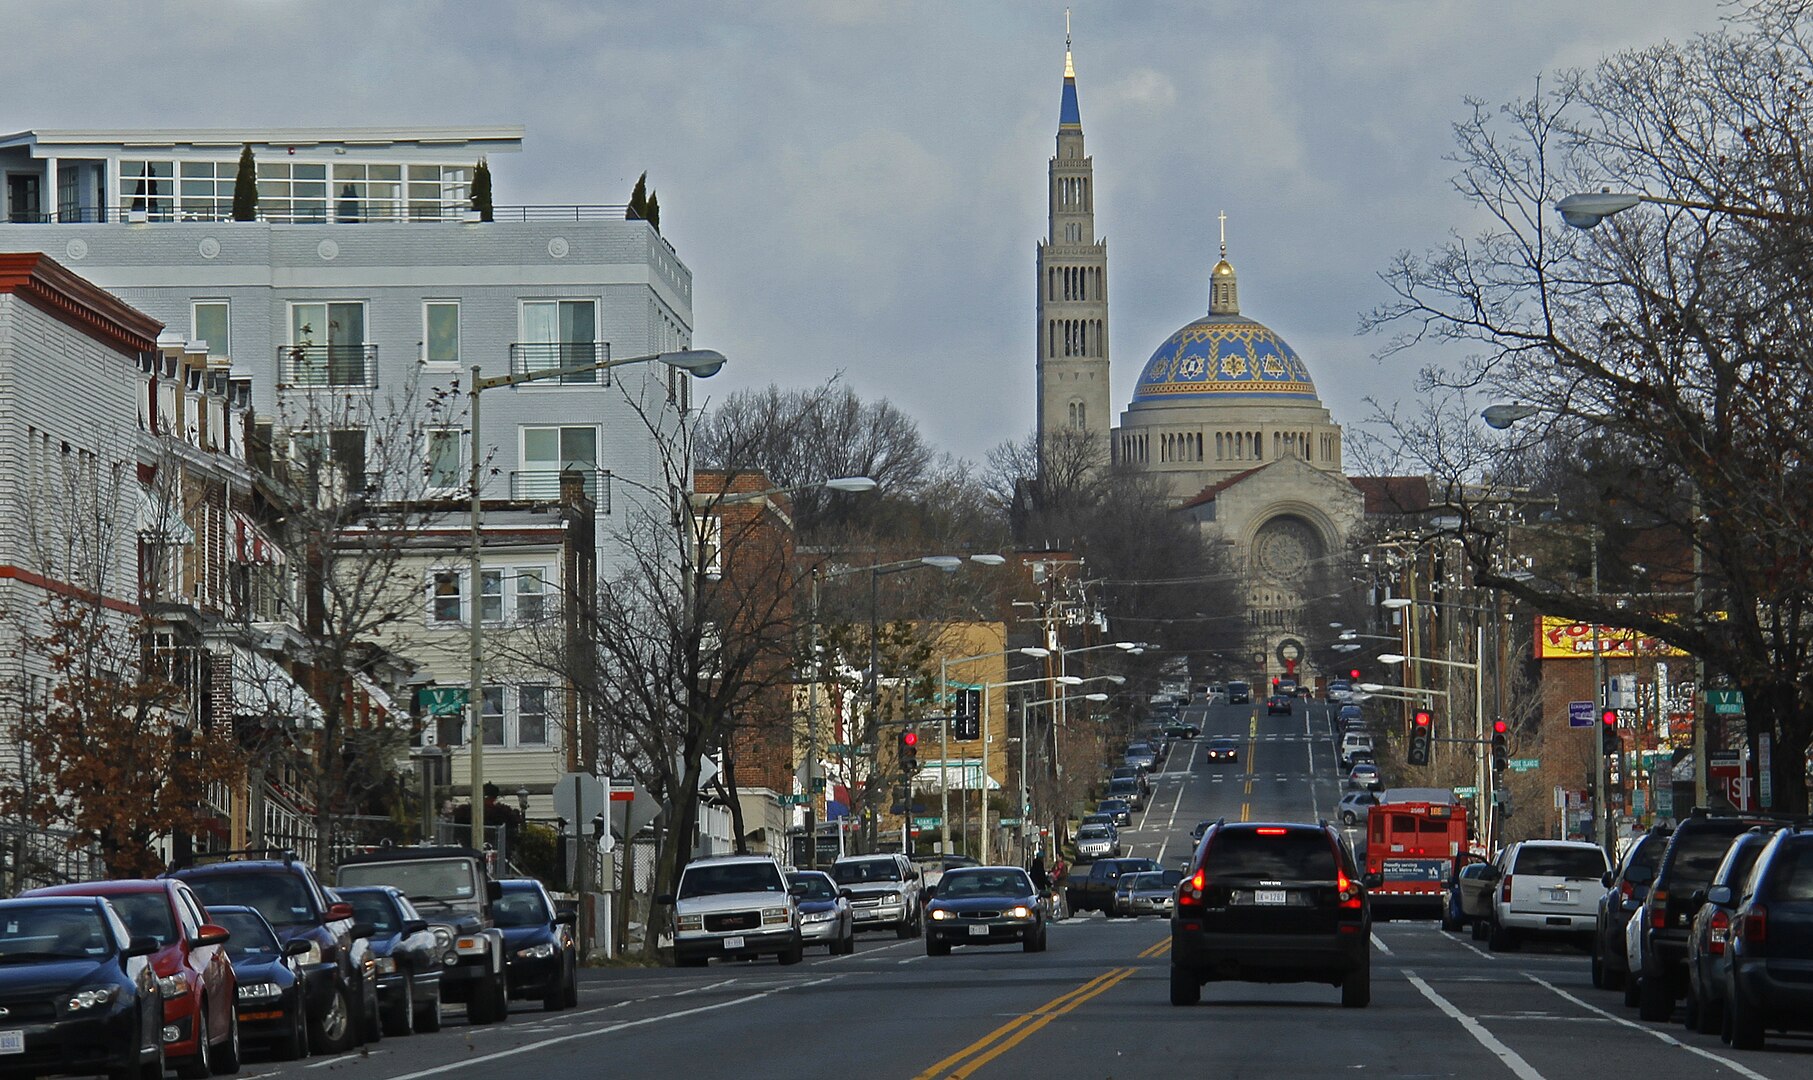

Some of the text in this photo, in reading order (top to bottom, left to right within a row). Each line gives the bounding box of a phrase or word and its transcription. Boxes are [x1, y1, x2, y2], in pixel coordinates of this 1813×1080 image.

[432, 690, 445, 704] V
[1719, 691, 1730, 703] V
[1453, 786, 1473, 794] ADAMS
